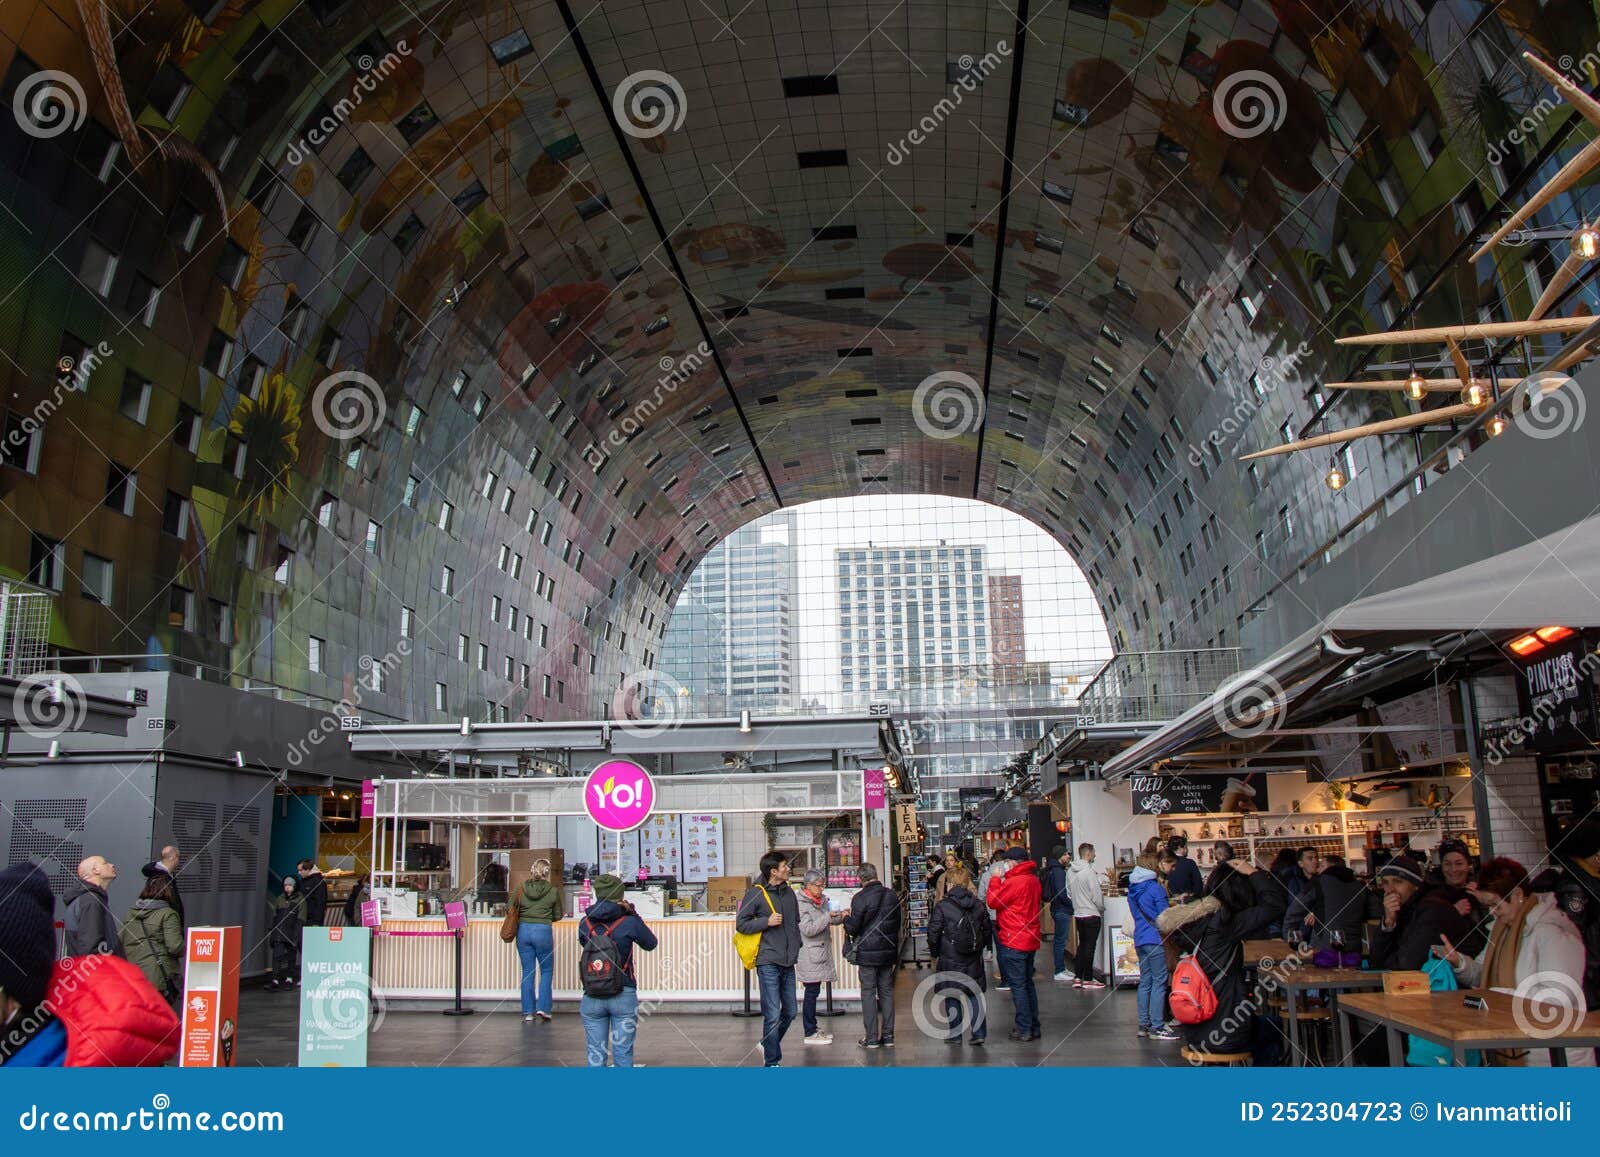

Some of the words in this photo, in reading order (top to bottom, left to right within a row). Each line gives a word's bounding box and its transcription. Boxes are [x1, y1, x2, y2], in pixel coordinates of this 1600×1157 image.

[869, 704, 889, 716] 52
[148, 719, 164, 729] 86
[342, 718, 360, 728] 56
[1078, 716, 1095, 726] 32
[1131, 776, 1163, 792] ICED
[592, 777, 644, 809] YO!
[901, 804, 913, 833] TEA
[899, 834, 917, 843] BAR
[307, 962, 362, 974] WELKOM
[306, 989, 362, 1000] MARKTHAL
